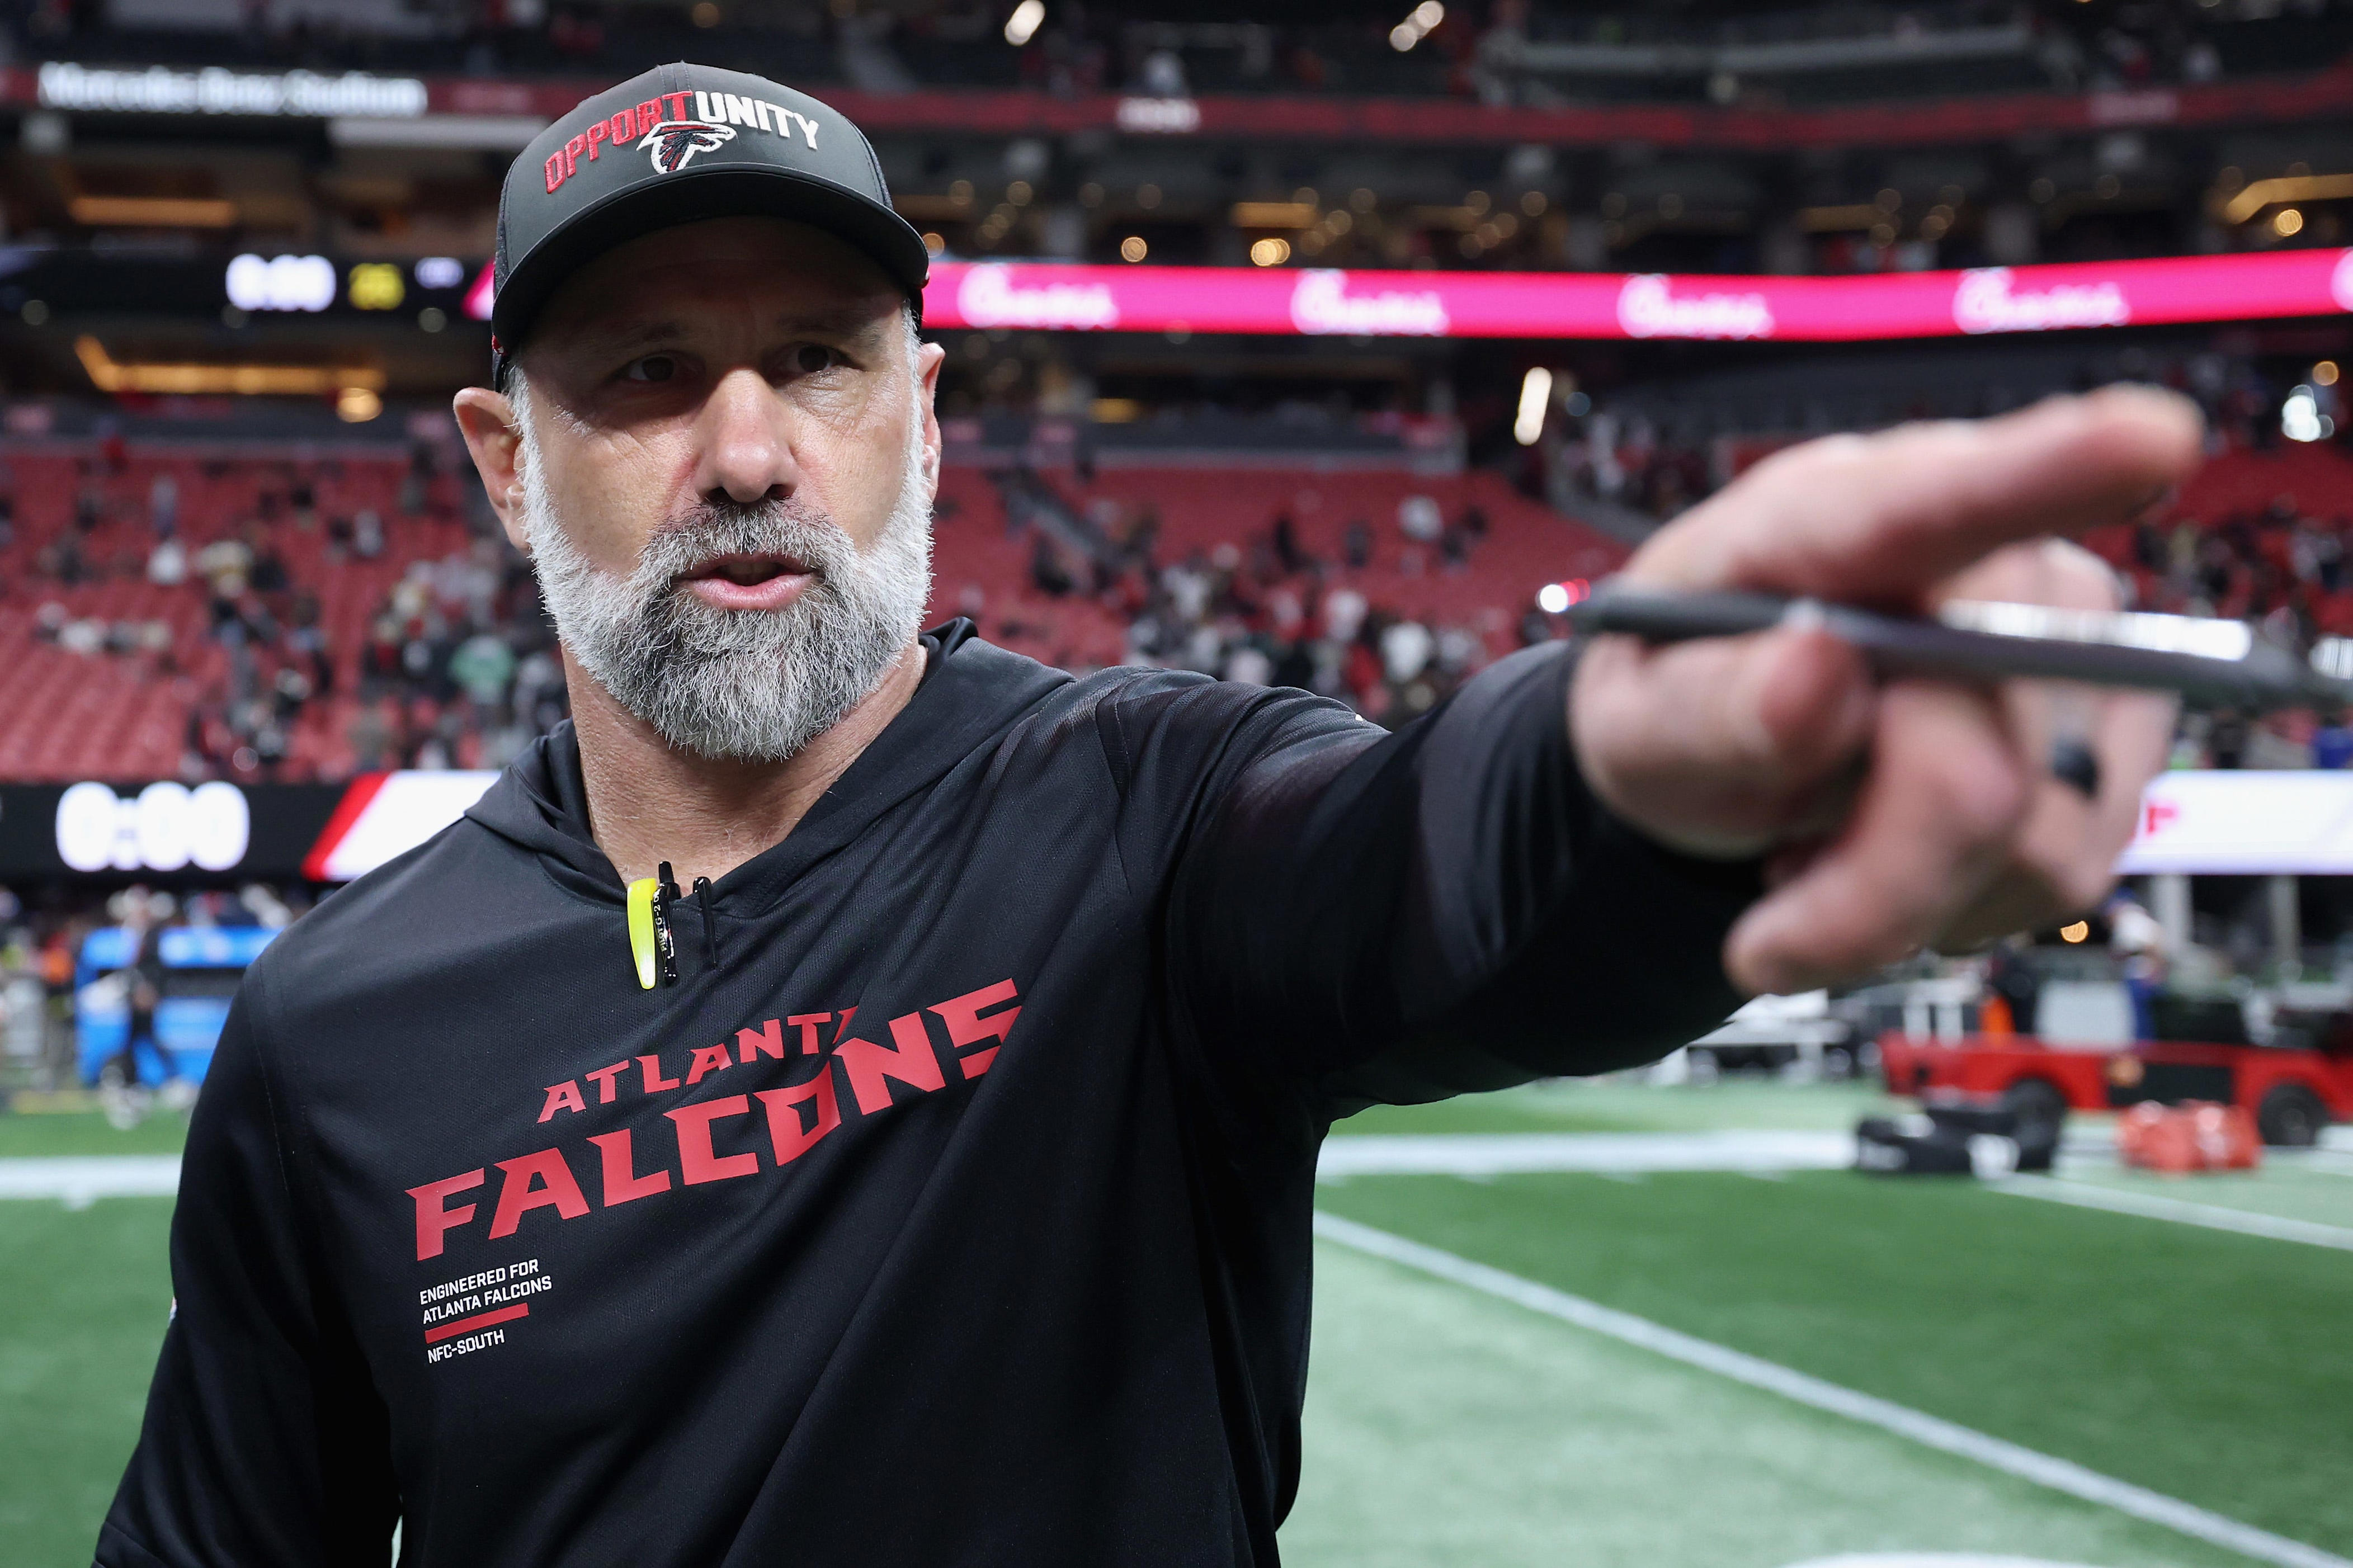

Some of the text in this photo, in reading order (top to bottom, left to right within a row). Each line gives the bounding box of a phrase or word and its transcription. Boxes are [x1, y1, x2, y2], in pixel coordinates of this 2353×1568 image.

[544, 90, 819, 194] OPPORTUNITY
[56, 781, 249, 871] 0:00
[405, 978, 1022, 1261] FALCONS
[419, 1259, 539, 1305] ENGINEERED FOR
[423, 1275, 552, 1324] ATLANTA FALCONS
[427, 1329, 504, 1364] NFC-SOUTH
